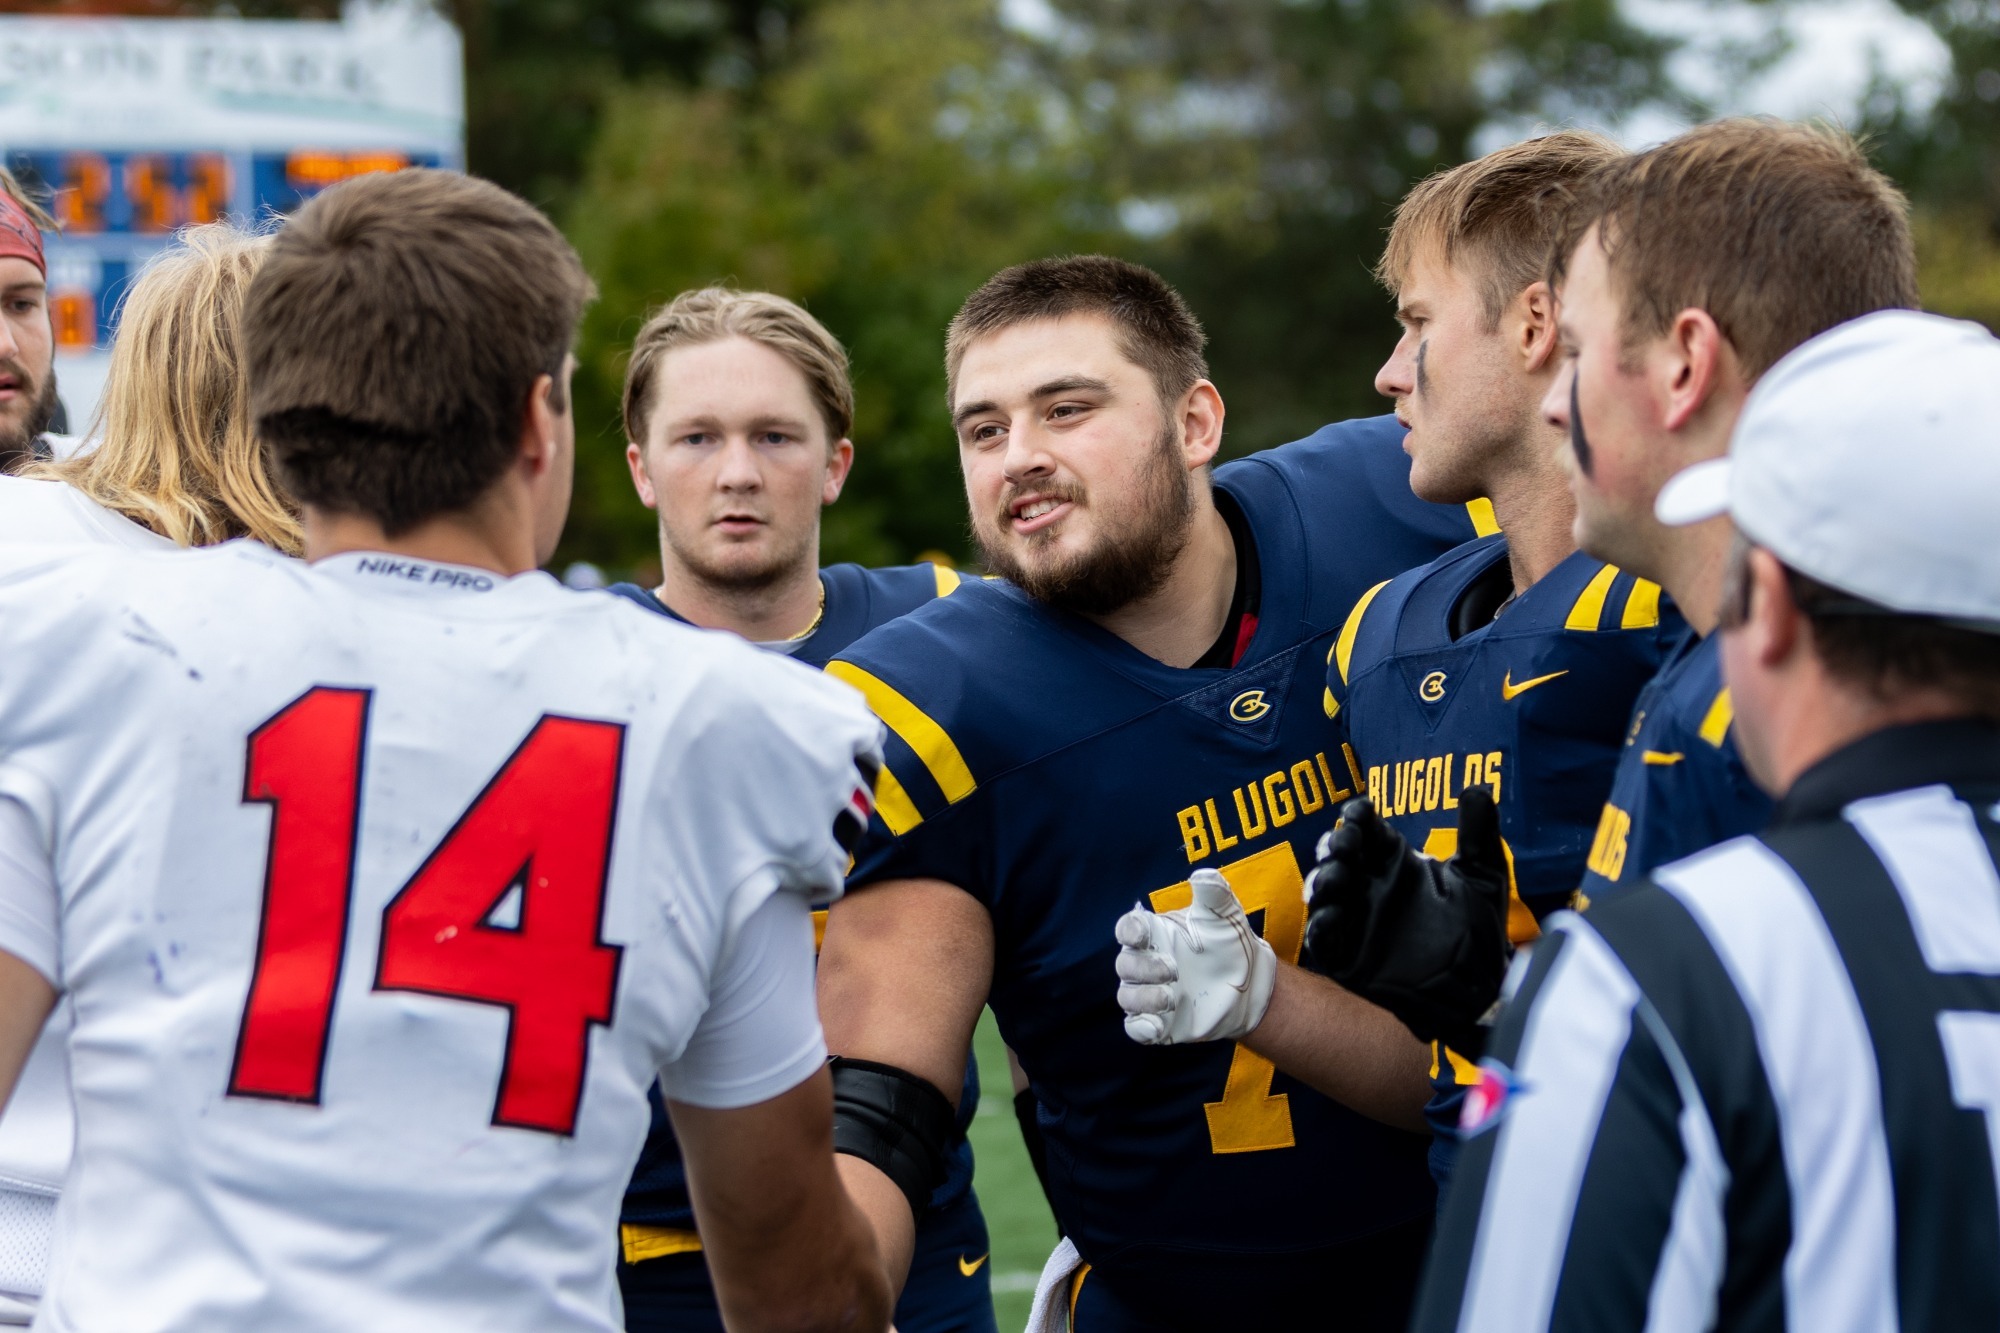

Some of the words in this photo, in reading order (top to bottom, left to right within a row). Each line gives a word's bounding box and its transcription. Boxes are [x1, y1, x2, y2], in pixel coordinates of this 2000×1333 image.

[357, 557, 429, 582] NIKE
[429, 567, 494, 593] PRO
[226, 684, 630, 1138] 14
